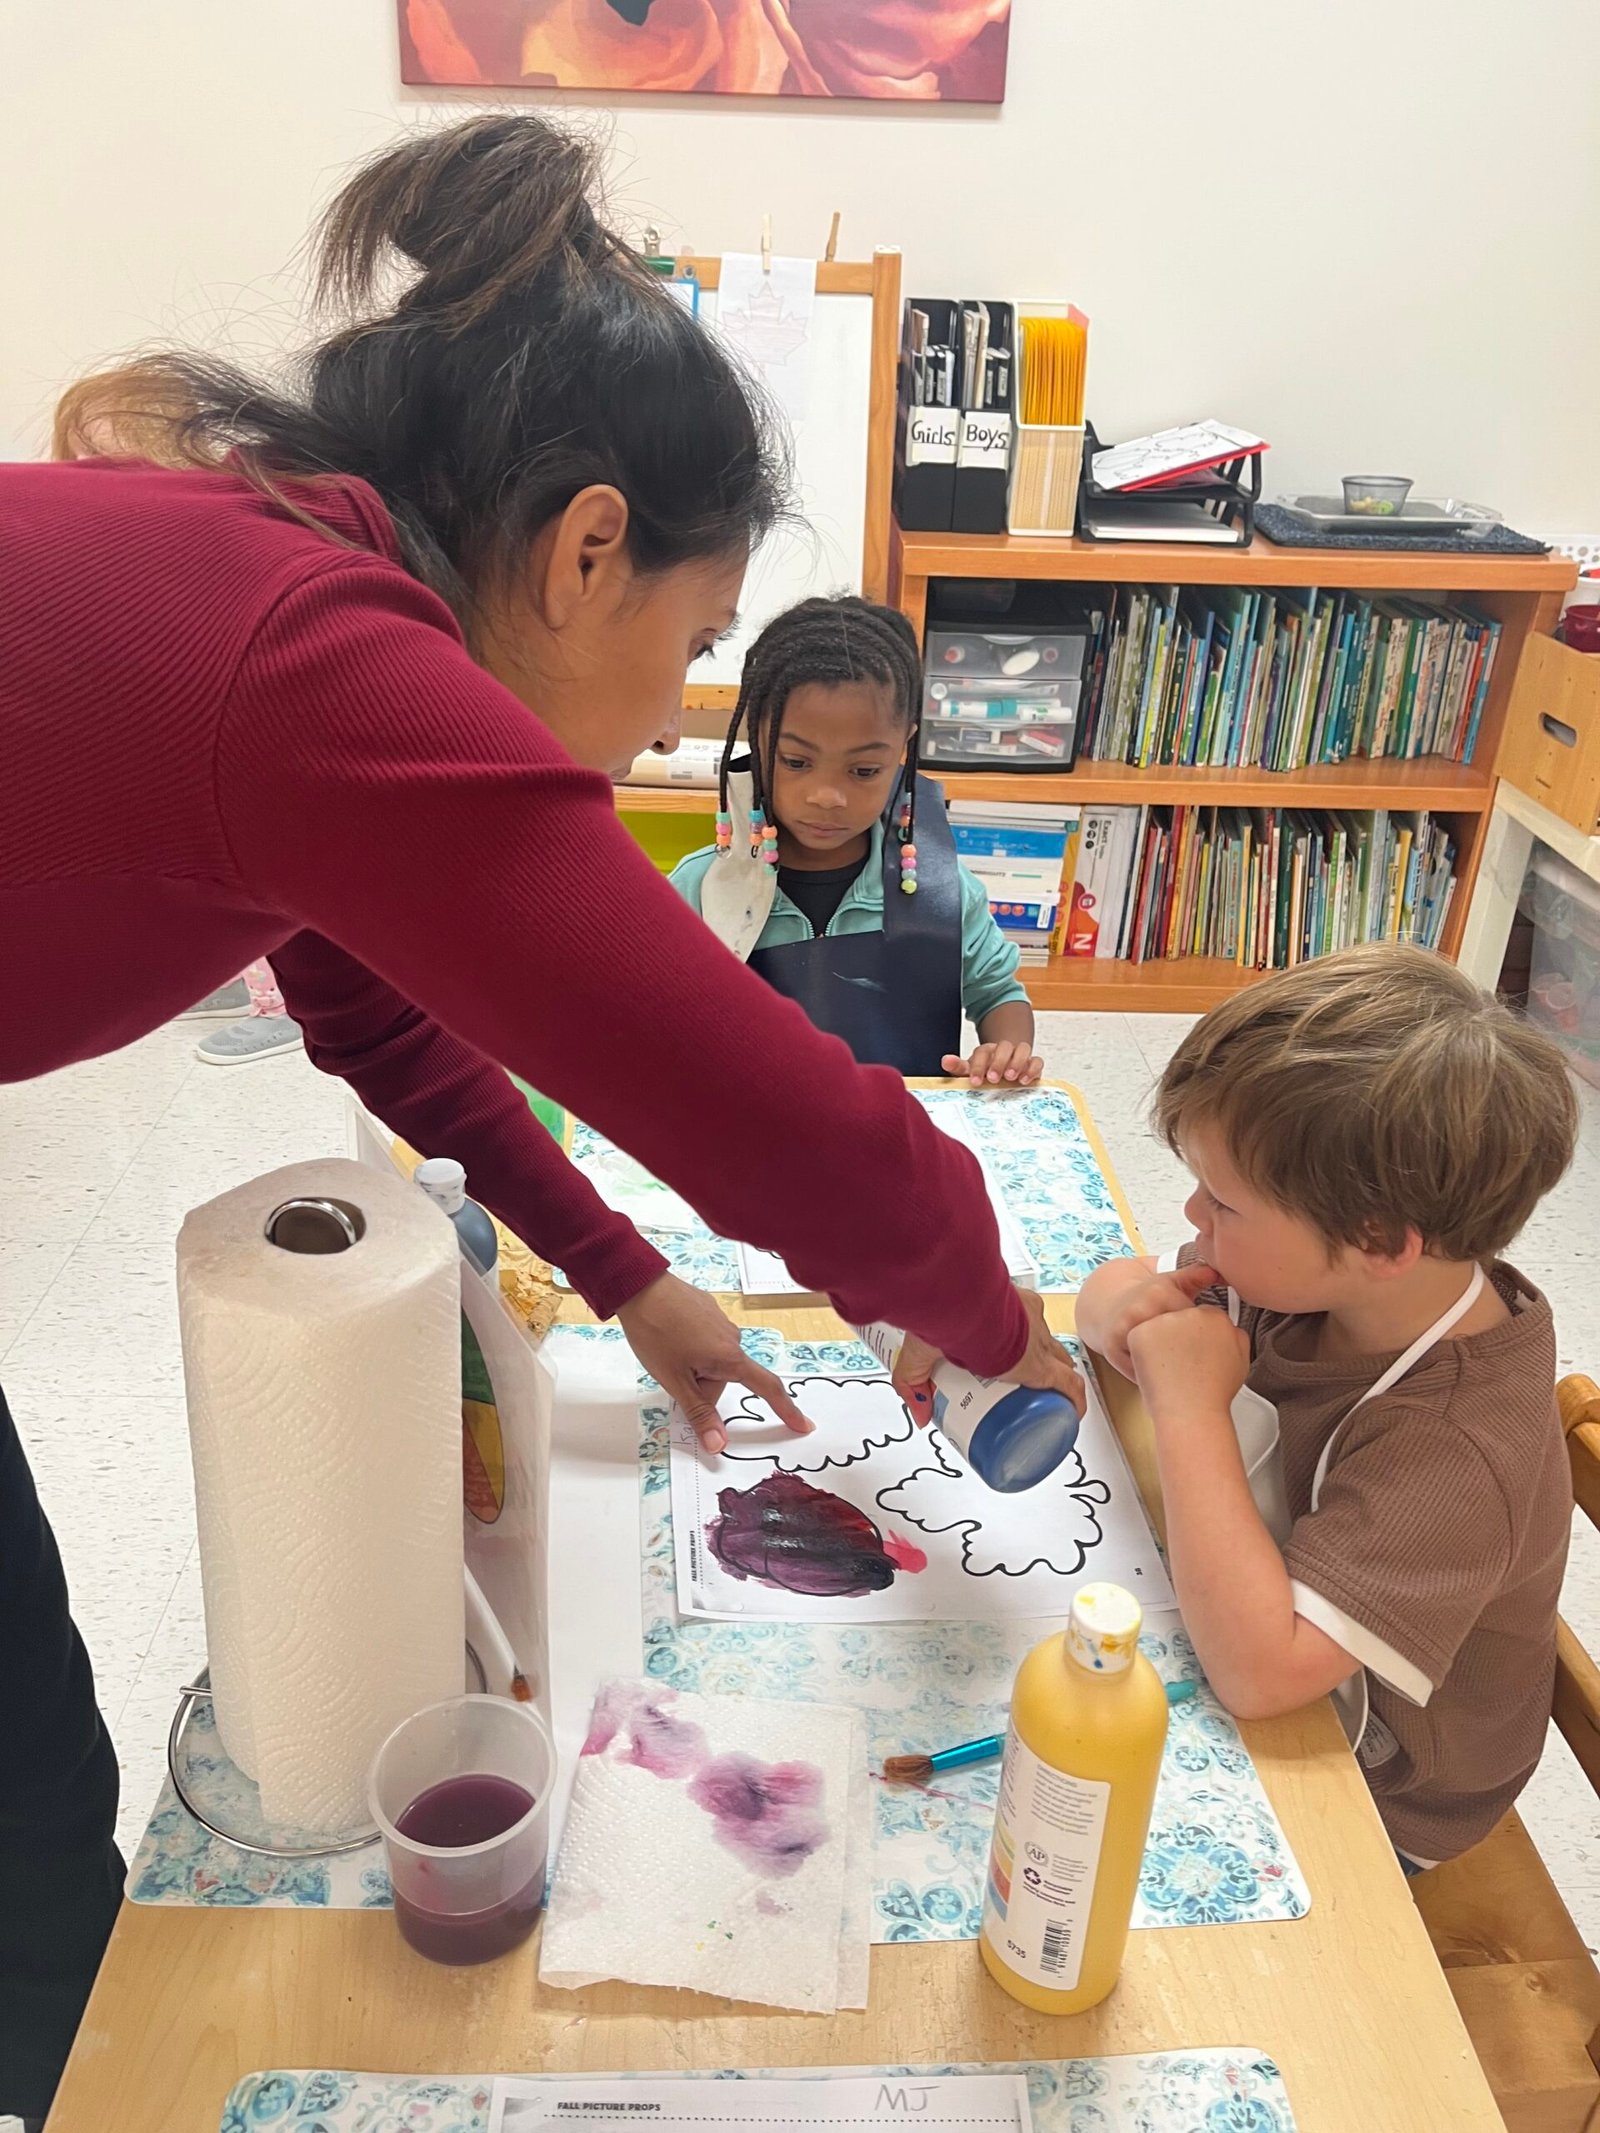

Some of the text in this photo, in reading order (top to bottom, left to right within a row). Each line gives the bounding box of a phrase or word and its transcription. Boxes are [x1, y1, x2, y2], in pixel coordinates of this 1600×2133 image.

[911, 420, 955, 446] Girls
[966, 423, 1010, 452] Boys
[960, 1391, 974, 1410] 5697
[1028, 1848, 1046, 1861] AP
[1007, 1939, 1026, 1959] 5735
[557, 2101, 661, 2112] FALL PICTURE PROPS
[874, 2083, 941, 2112] MJ
